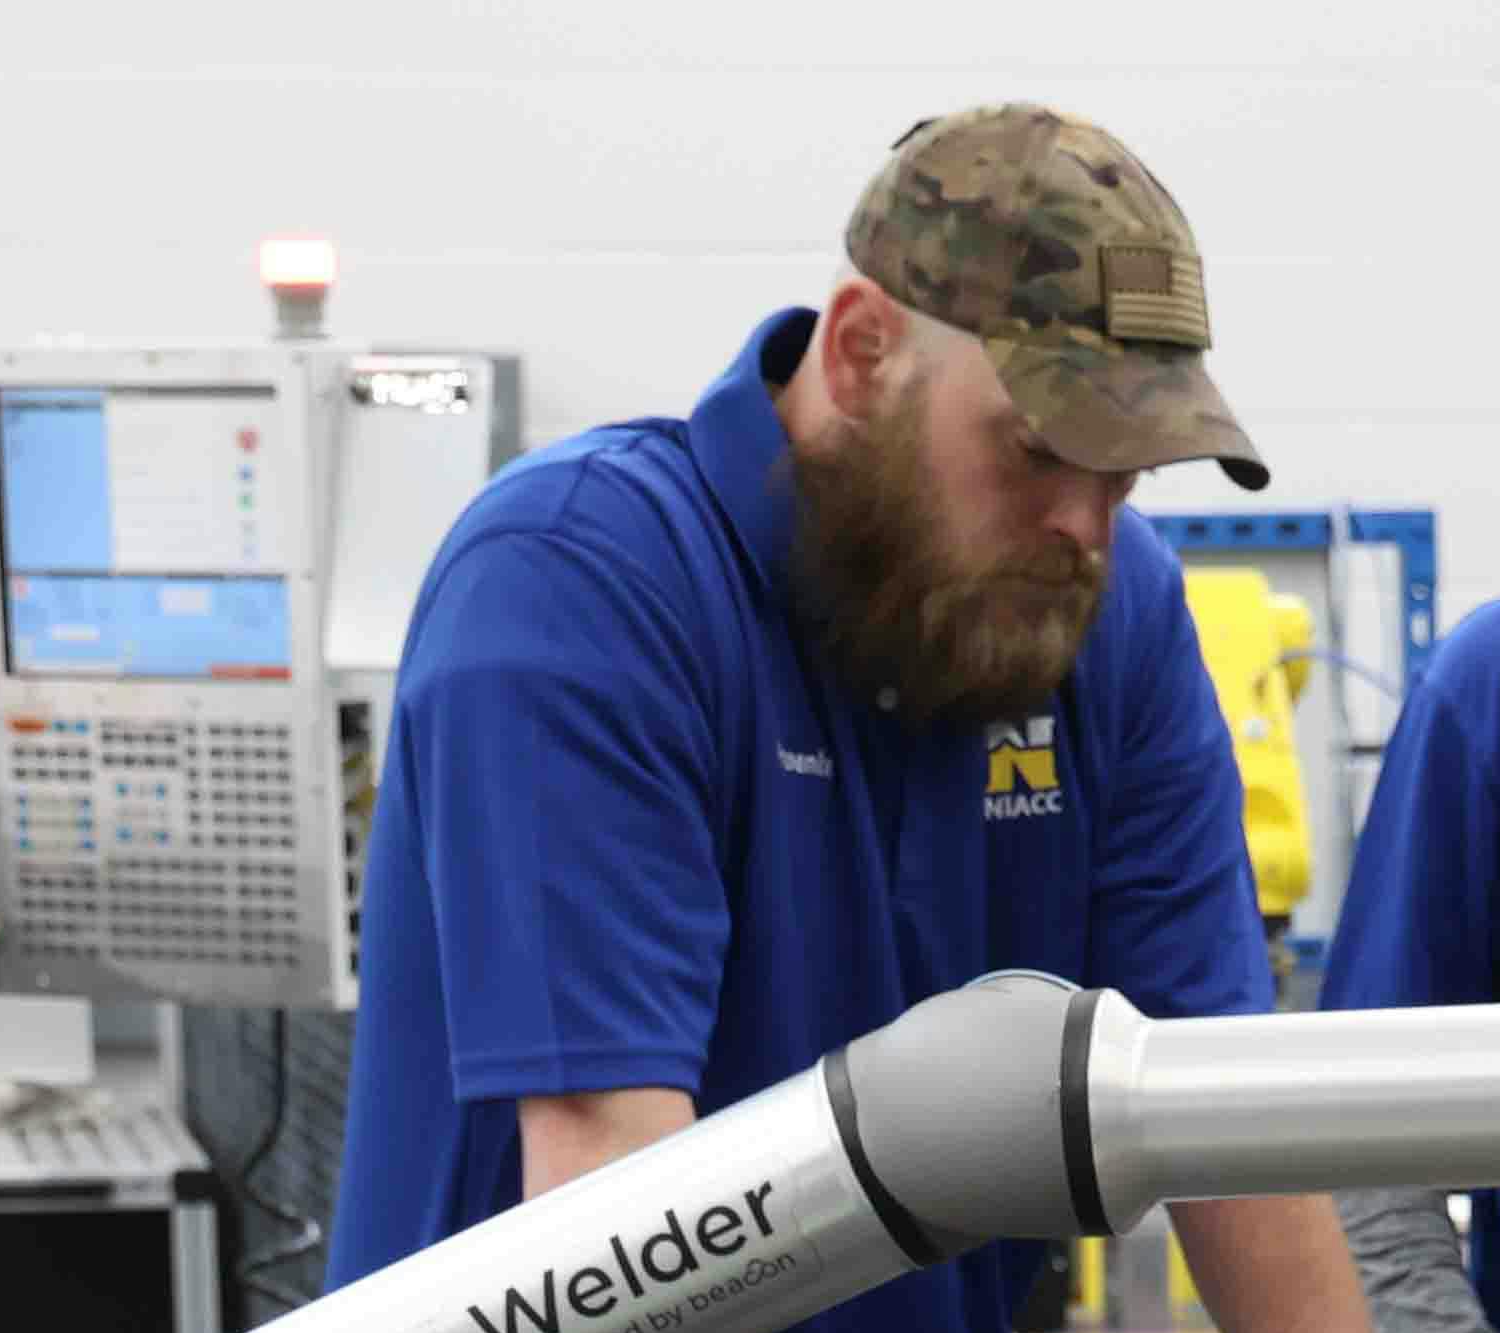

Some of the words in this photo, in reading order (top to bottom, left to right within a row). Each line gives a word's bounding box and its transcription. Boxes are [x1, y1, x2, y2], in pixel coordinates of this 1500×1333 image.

[984, 791, 1064, 819] NIACC
[645, 1305, 685, 1333] by
[687, 1251, 798, 1312] beacon
